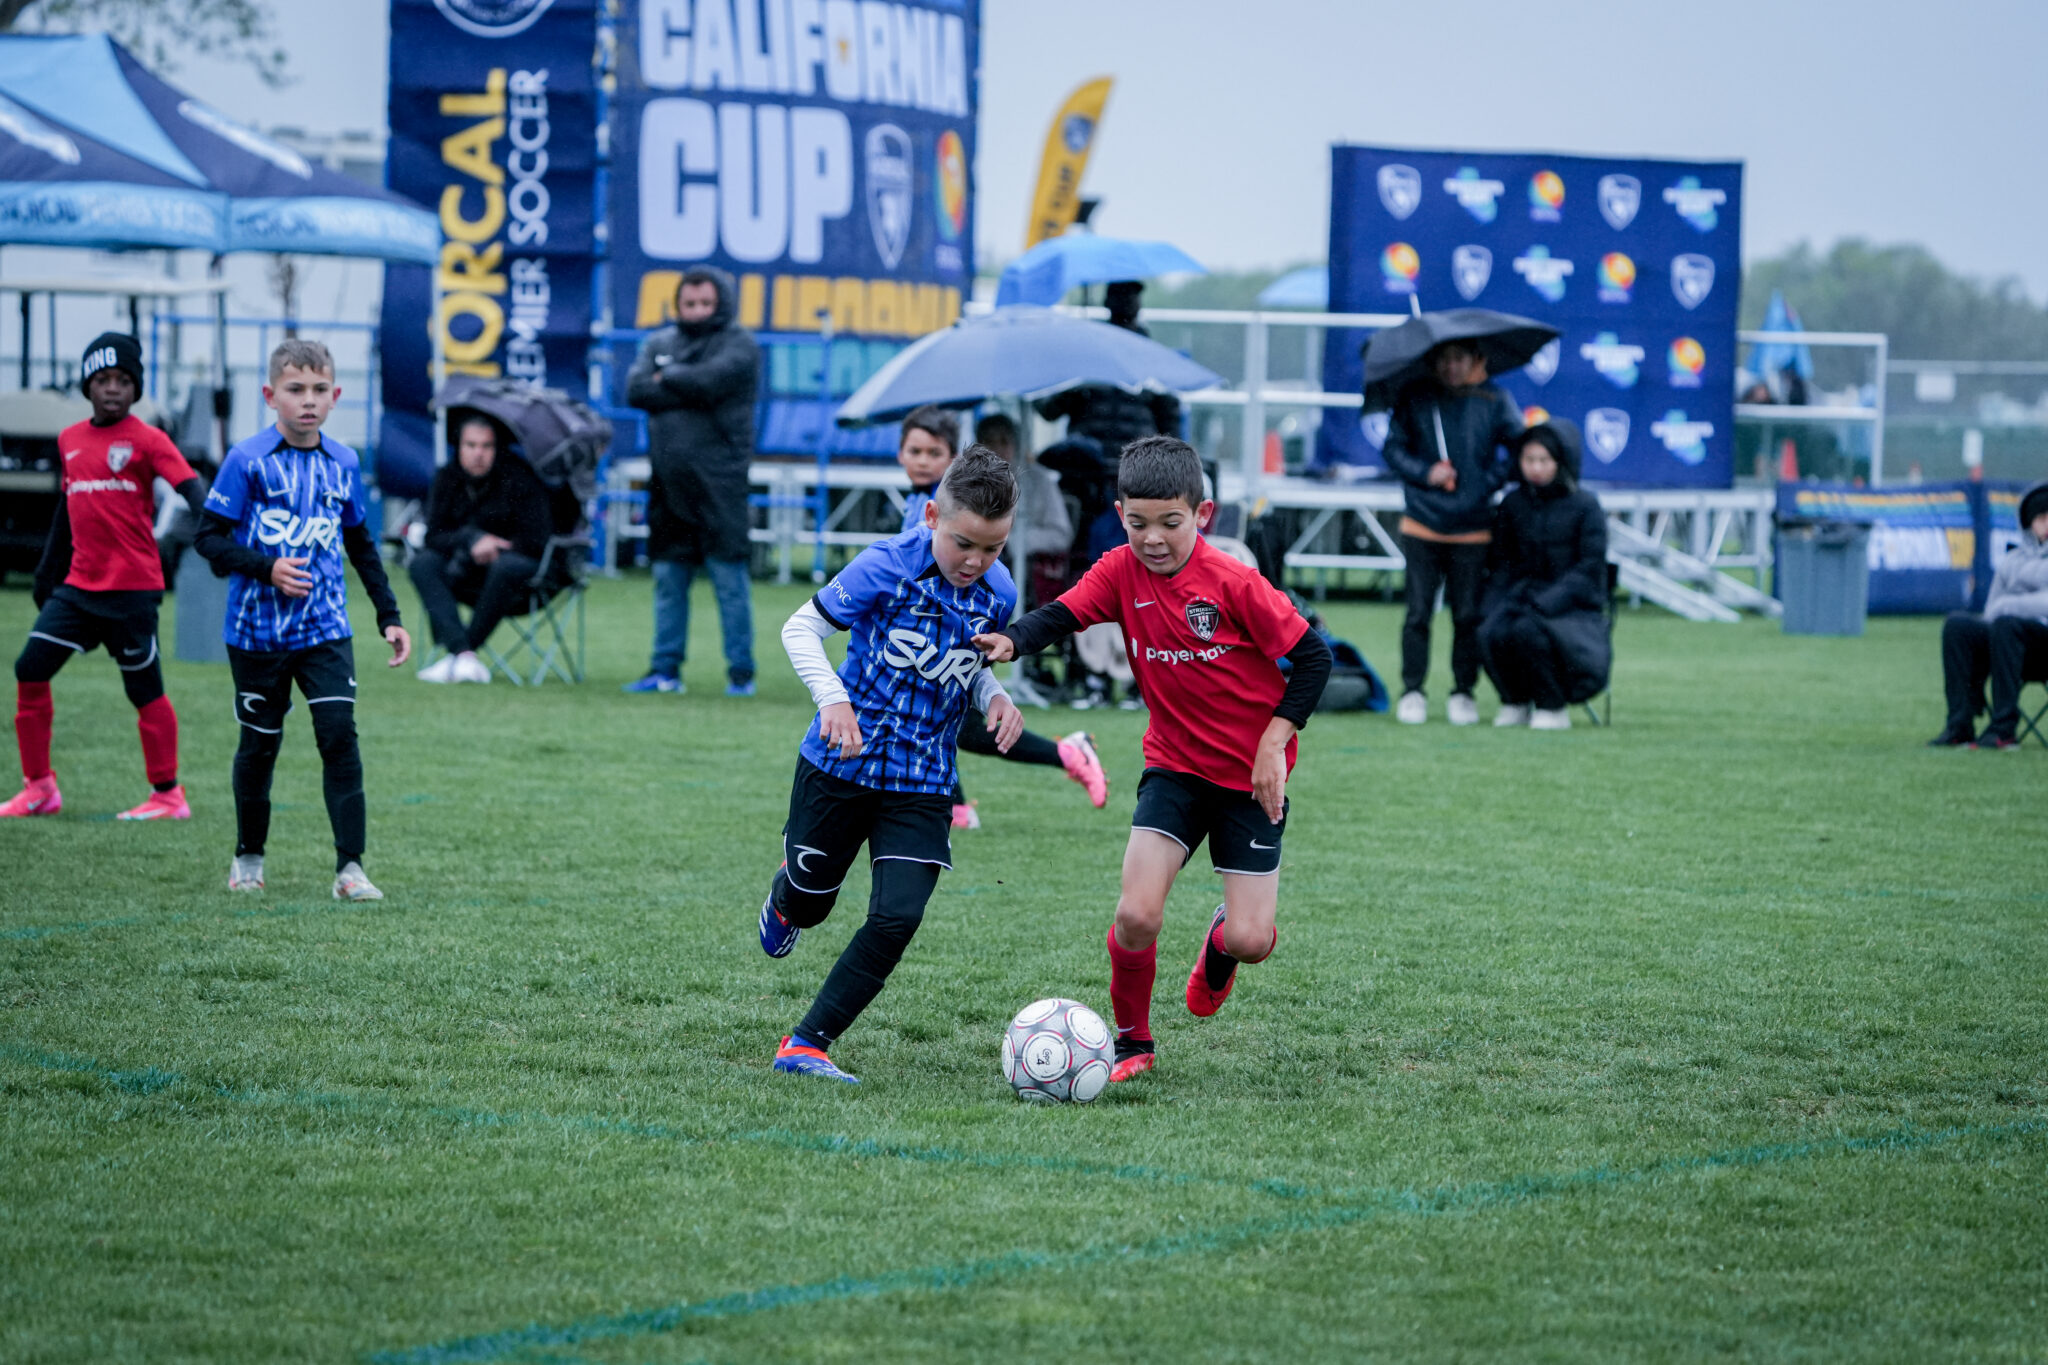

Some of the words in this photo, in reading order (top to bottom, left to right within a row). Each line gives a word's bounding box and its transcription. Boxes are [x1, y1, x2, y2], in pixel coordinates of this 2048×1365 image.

[638, 0, 968, 118] CALIFORNIA
[436, 68, 508, 379] ORCAL
[508, 68, 551, 246] SOCCER
[638, 97, 854, 263] CUP
[83, 346, 117, 379] KING
[831, 580, 851, 607] PNC
